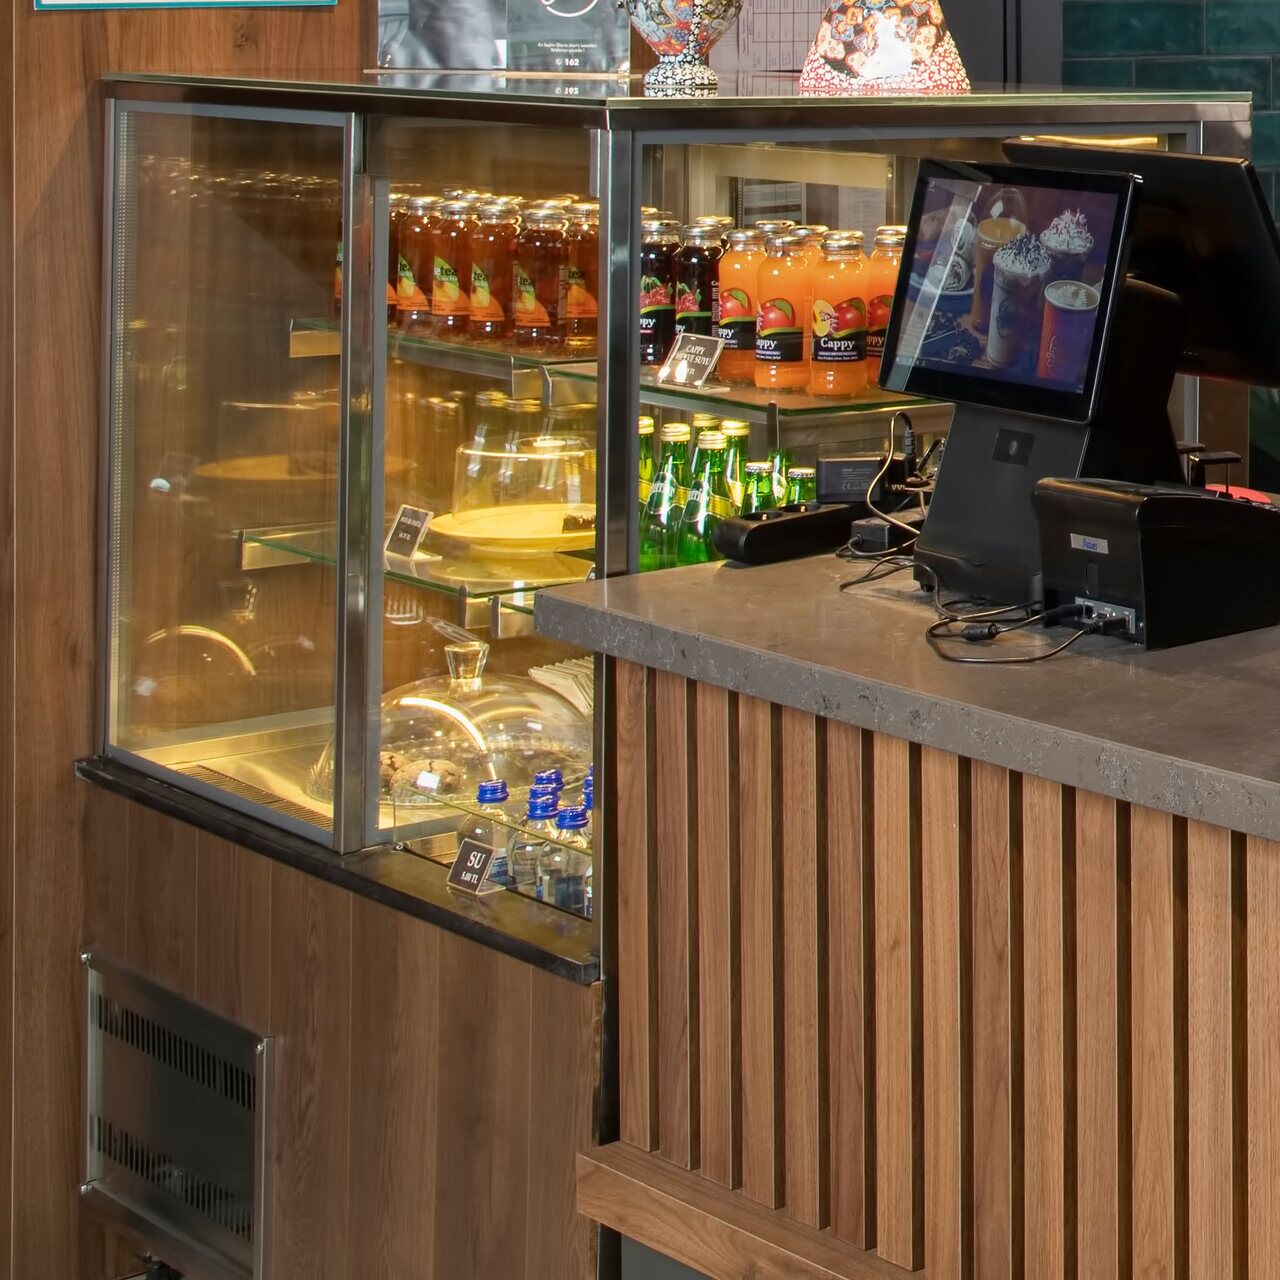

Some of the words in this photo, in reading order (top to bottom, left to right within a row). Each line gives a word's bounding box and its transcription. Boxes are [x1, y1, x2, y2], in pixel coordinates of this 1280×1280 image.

[564, 57, 580, 67] 162
[686, 344, 706, 355] CAPPY
[820, 336, 855, 351] Cappy
[467, 851, 486, 869] SU
